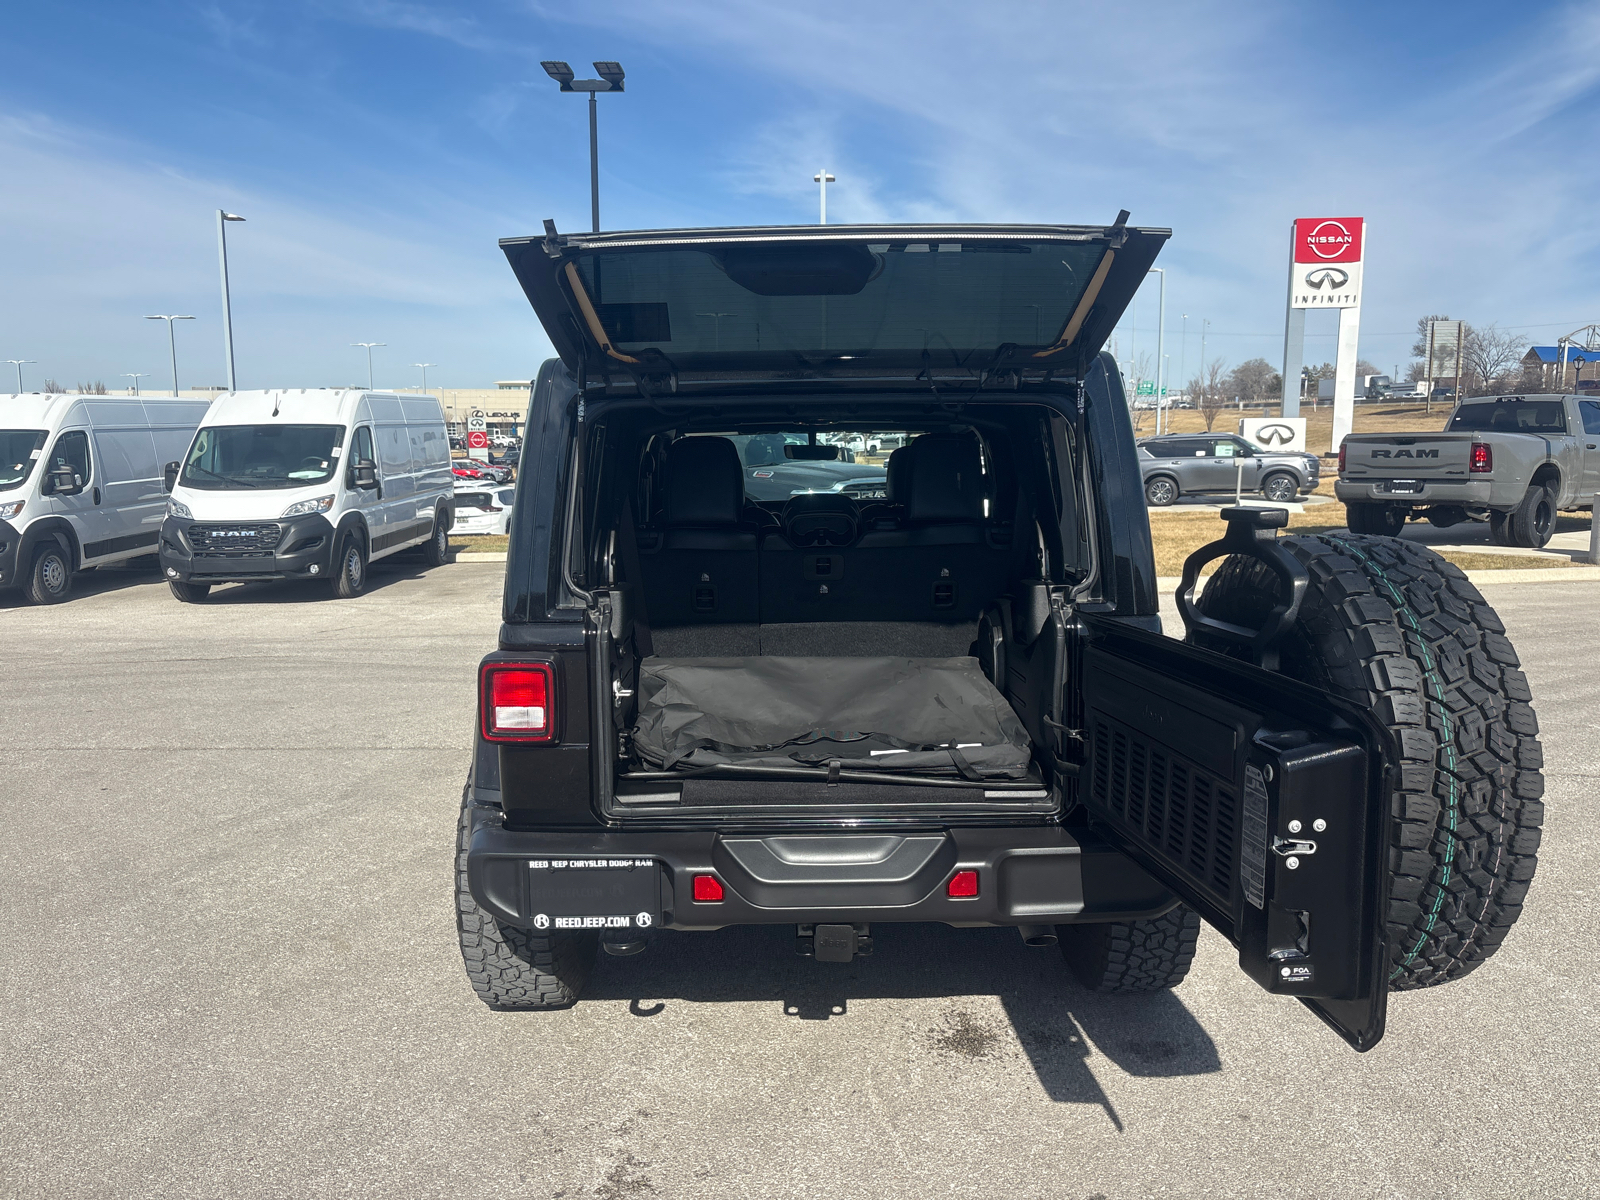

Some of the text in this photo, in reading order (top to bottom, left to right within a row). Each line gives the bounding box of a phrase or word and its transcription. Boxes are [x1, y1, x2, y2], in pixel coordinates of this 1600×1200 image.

[1295, 294, 1357, 304] INFINITI
[1371, 449, 1439, 459] RAM
[861, 490, 887, 498] RA
[529, 861, 549, 869] REED
[570, 860, 607, 868] CHRYSLER
[635, 859, 653, 867] RAM
[555, 917, 630, 928] REEDJEEP.COM
